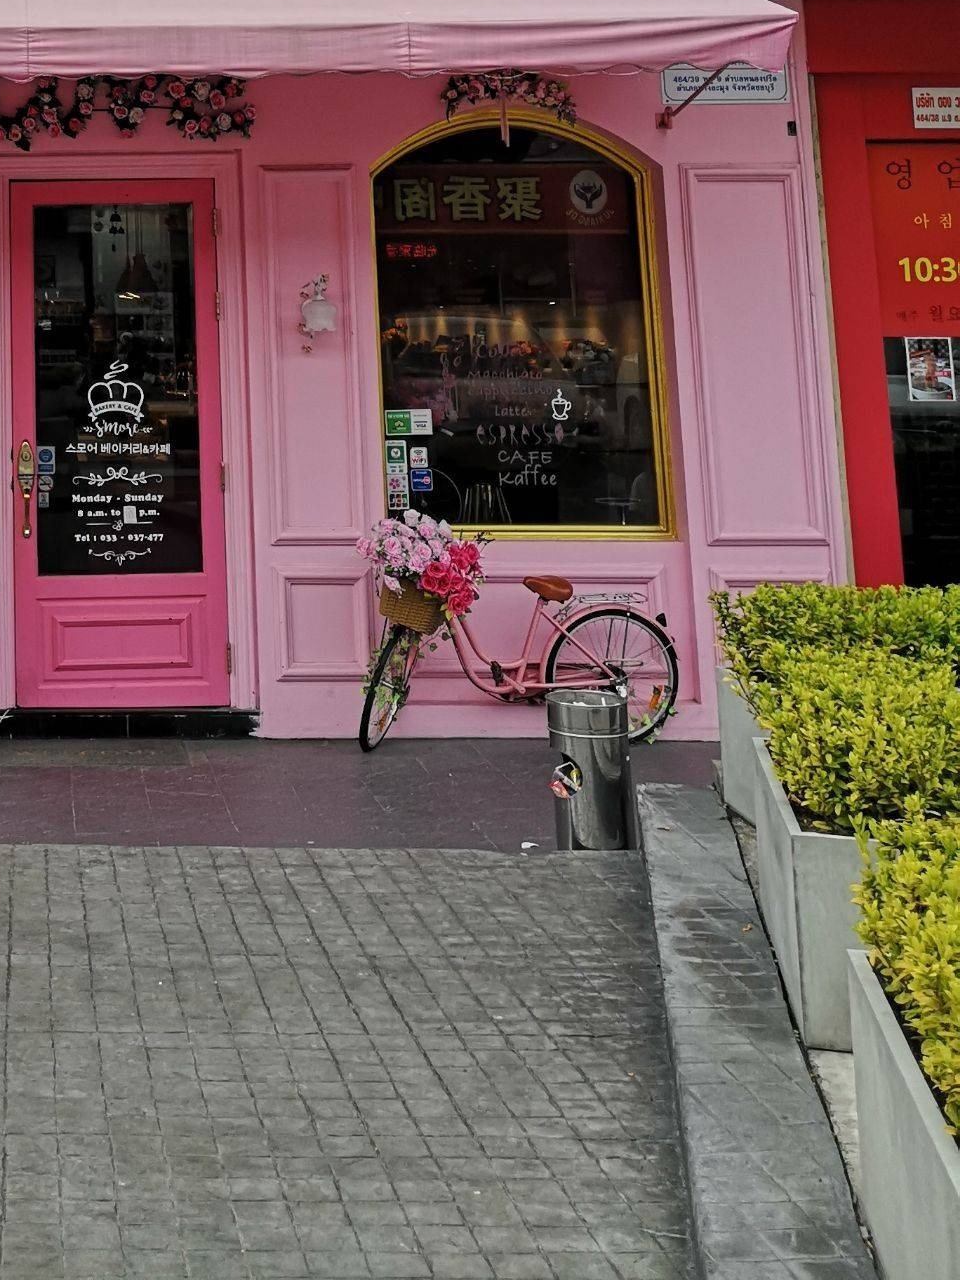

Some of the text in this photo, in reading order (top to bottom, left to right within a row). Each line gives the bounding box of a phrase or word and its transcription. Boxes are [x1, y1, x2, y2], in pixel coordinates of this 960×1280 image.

[898, 256, 960, 283] 10:3
[65, 442, 171, 456] 스모어 베이커리&카페
[498, 450, 553, 464] CAFE
[498, 464, 557, 486] Kaffee
[72, 493, 112, 504] Monday
[124, 493, 164, 503] Sunday
[111, 508, 121, 517] to
[139, 509, 160, 518] p.m.
[74, 534, 91, 542] Tel
